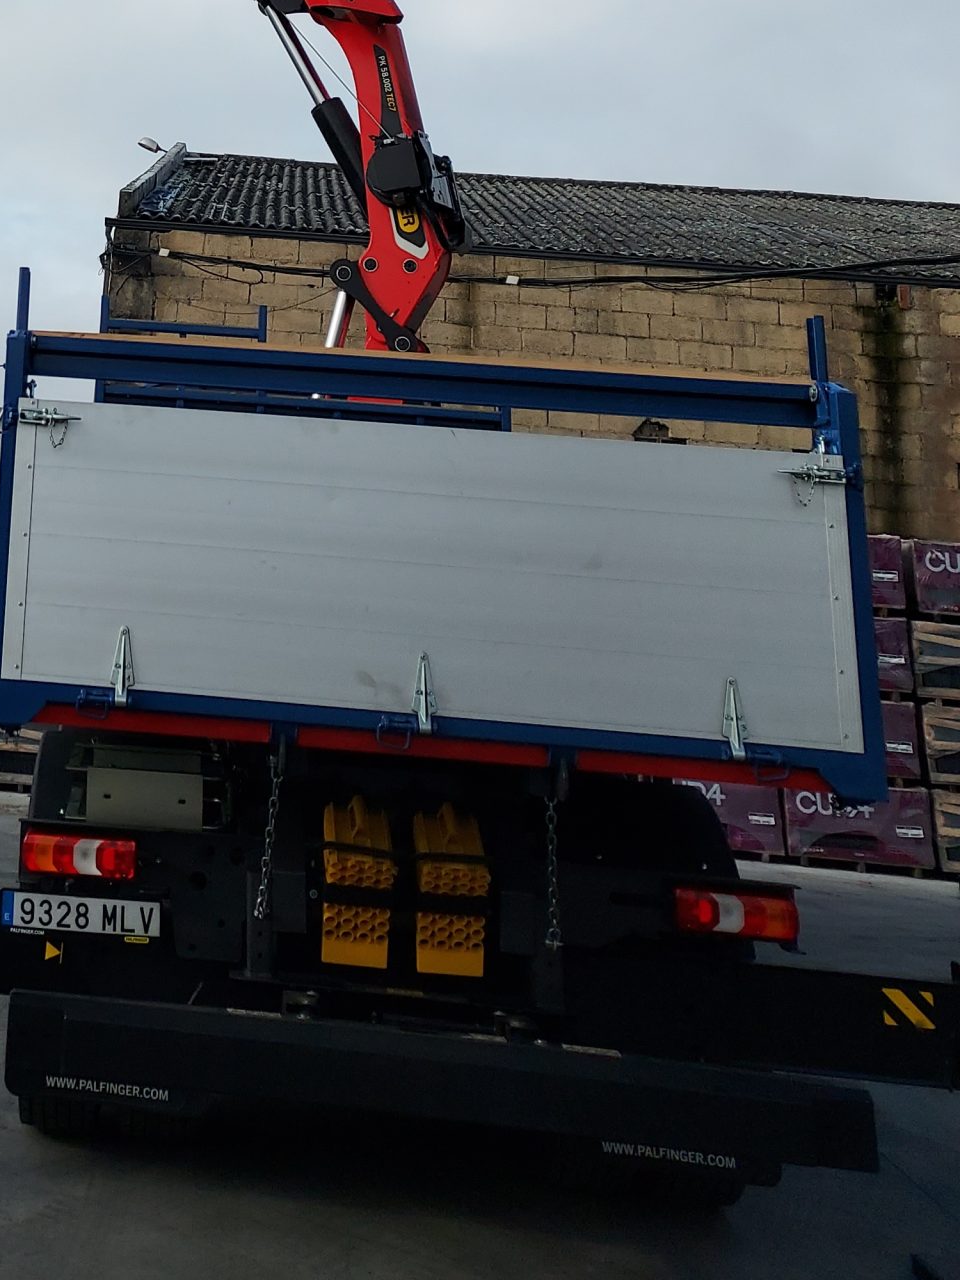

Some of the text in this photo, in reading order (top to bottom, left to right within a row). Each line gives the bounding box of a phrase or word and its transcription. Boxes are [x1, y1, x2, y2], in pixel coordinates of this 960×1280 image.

[378, 55, 387, 66] PK
[386, 93, 397, 112] TEC7
[4, 913, 10, 921] E
[20, 898, 154, 934] 9328 MLV
[45, 1075, 169, 1101] WWW.PALFINGER.COM
[602, 1141, 737, 1168] WWW.PALFINGER.COM
